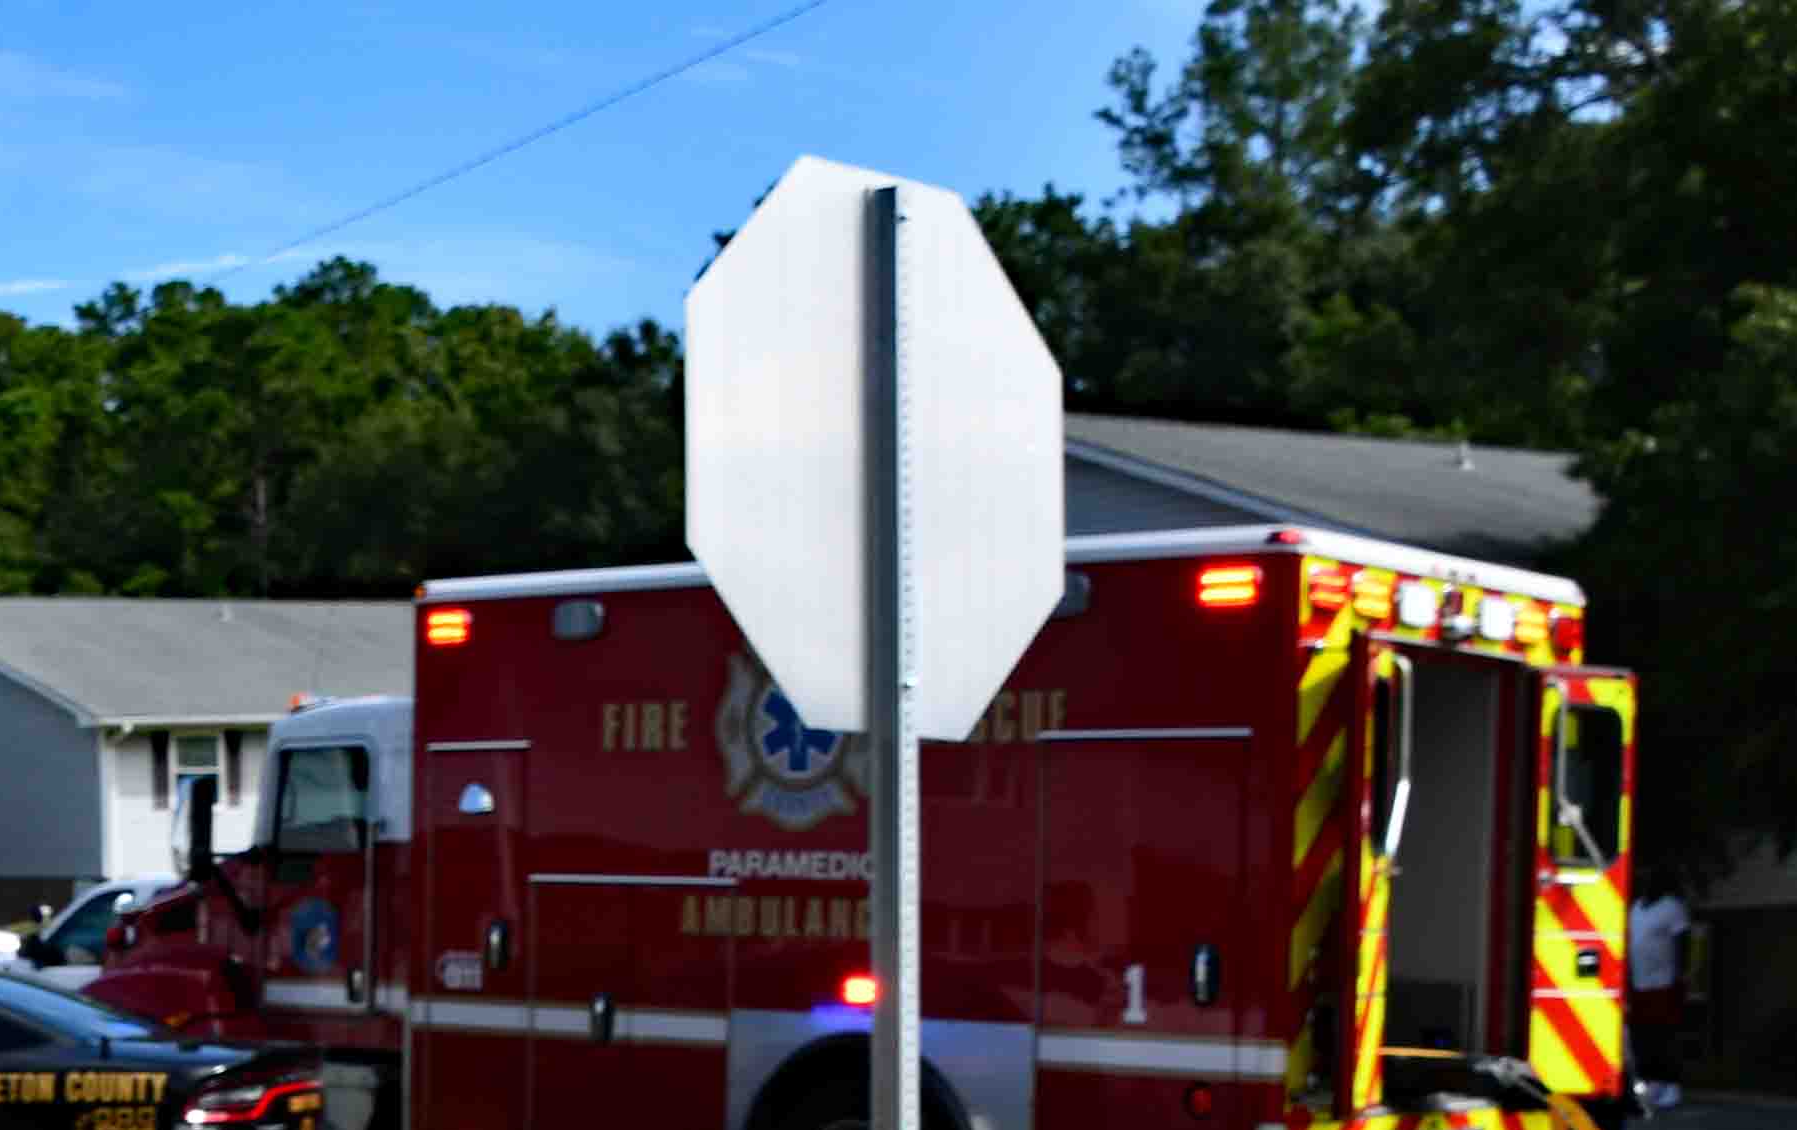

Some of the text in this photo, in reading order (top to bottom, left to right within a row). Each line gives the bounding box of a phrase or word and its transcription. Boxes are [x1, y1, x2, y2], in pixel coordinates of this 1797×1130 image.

[603, 703, 689, 752] FIRE
[709, 851, 876, 880] PARAMEDIC
[681, 895, 872, 940] AMBULANC
[1122, 963, 1147, 1024] 1
[65, 1071, 168, 1103] COUNTY
